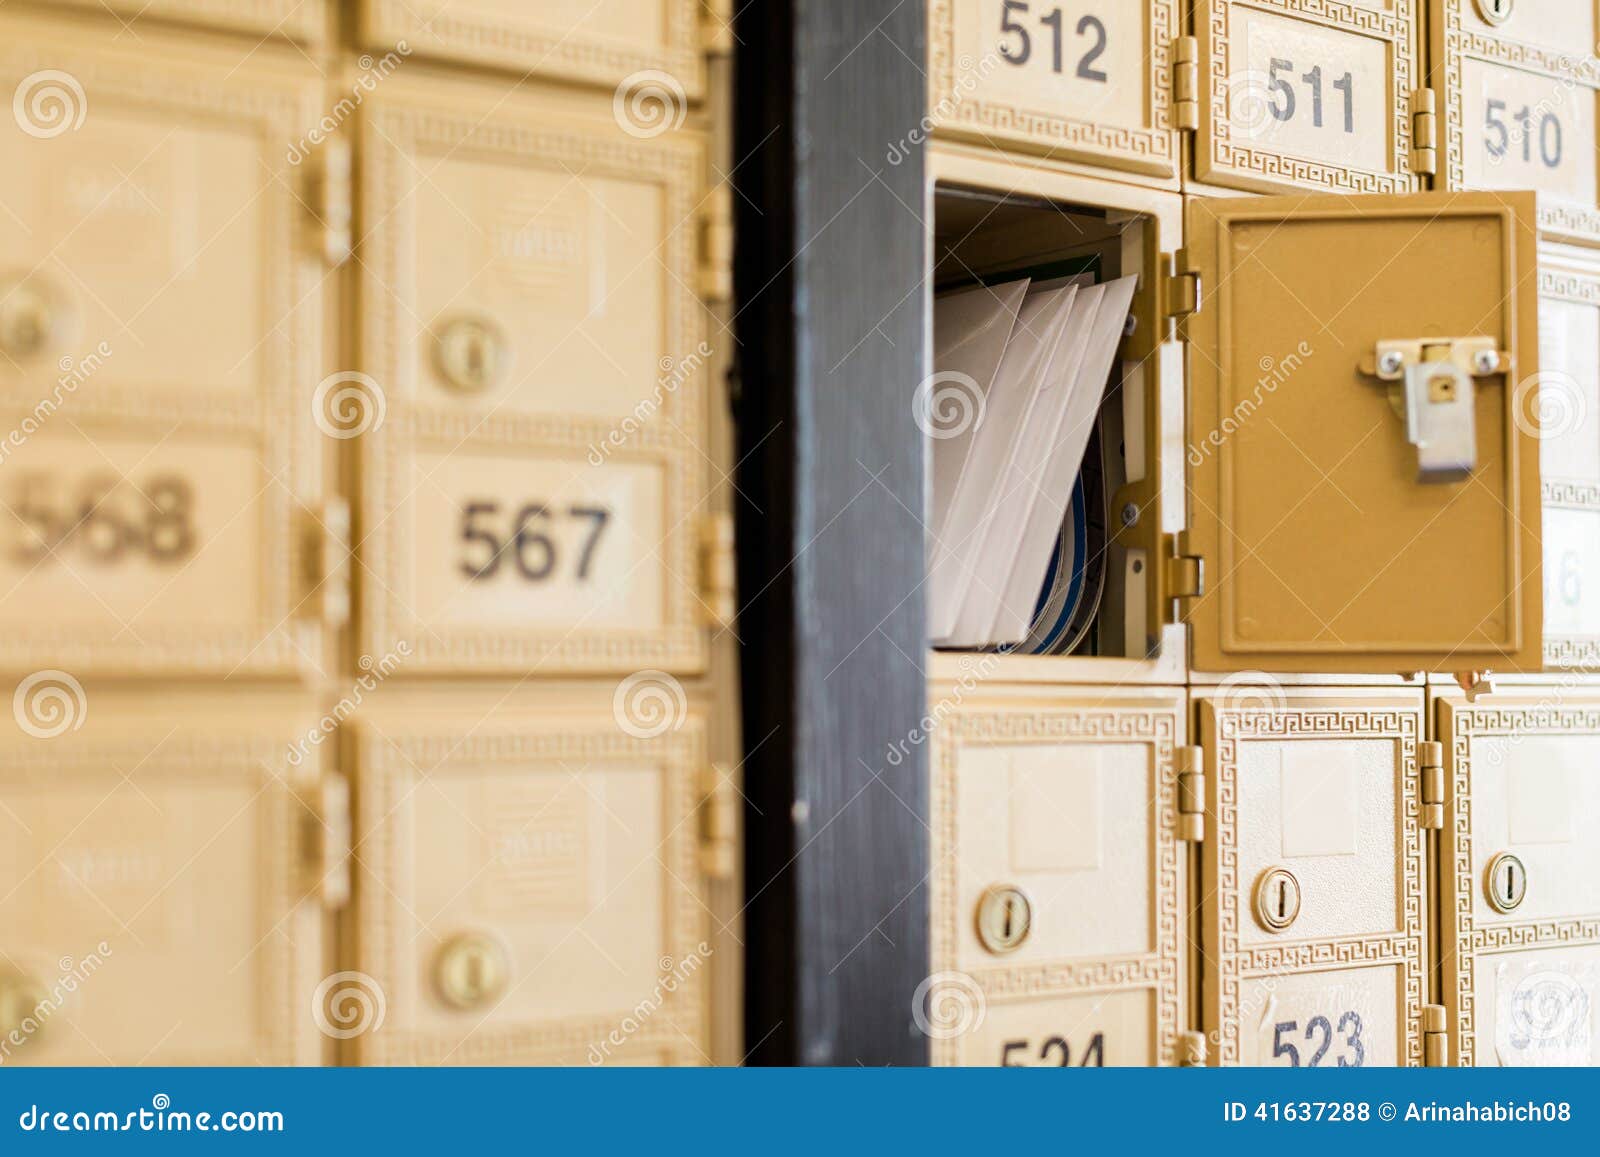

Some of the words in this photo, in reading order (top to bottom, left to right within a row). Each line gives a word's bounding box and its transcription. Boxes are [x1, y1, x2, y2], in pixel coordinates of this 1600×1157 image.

[1001, 0, 1108, 83] 512
[1266, 57, 1355, 133] 511
[1484, 98, 1562, 168] 510
[2, 471, 198, 567] 568
[456, 500, 613, 585] 567
